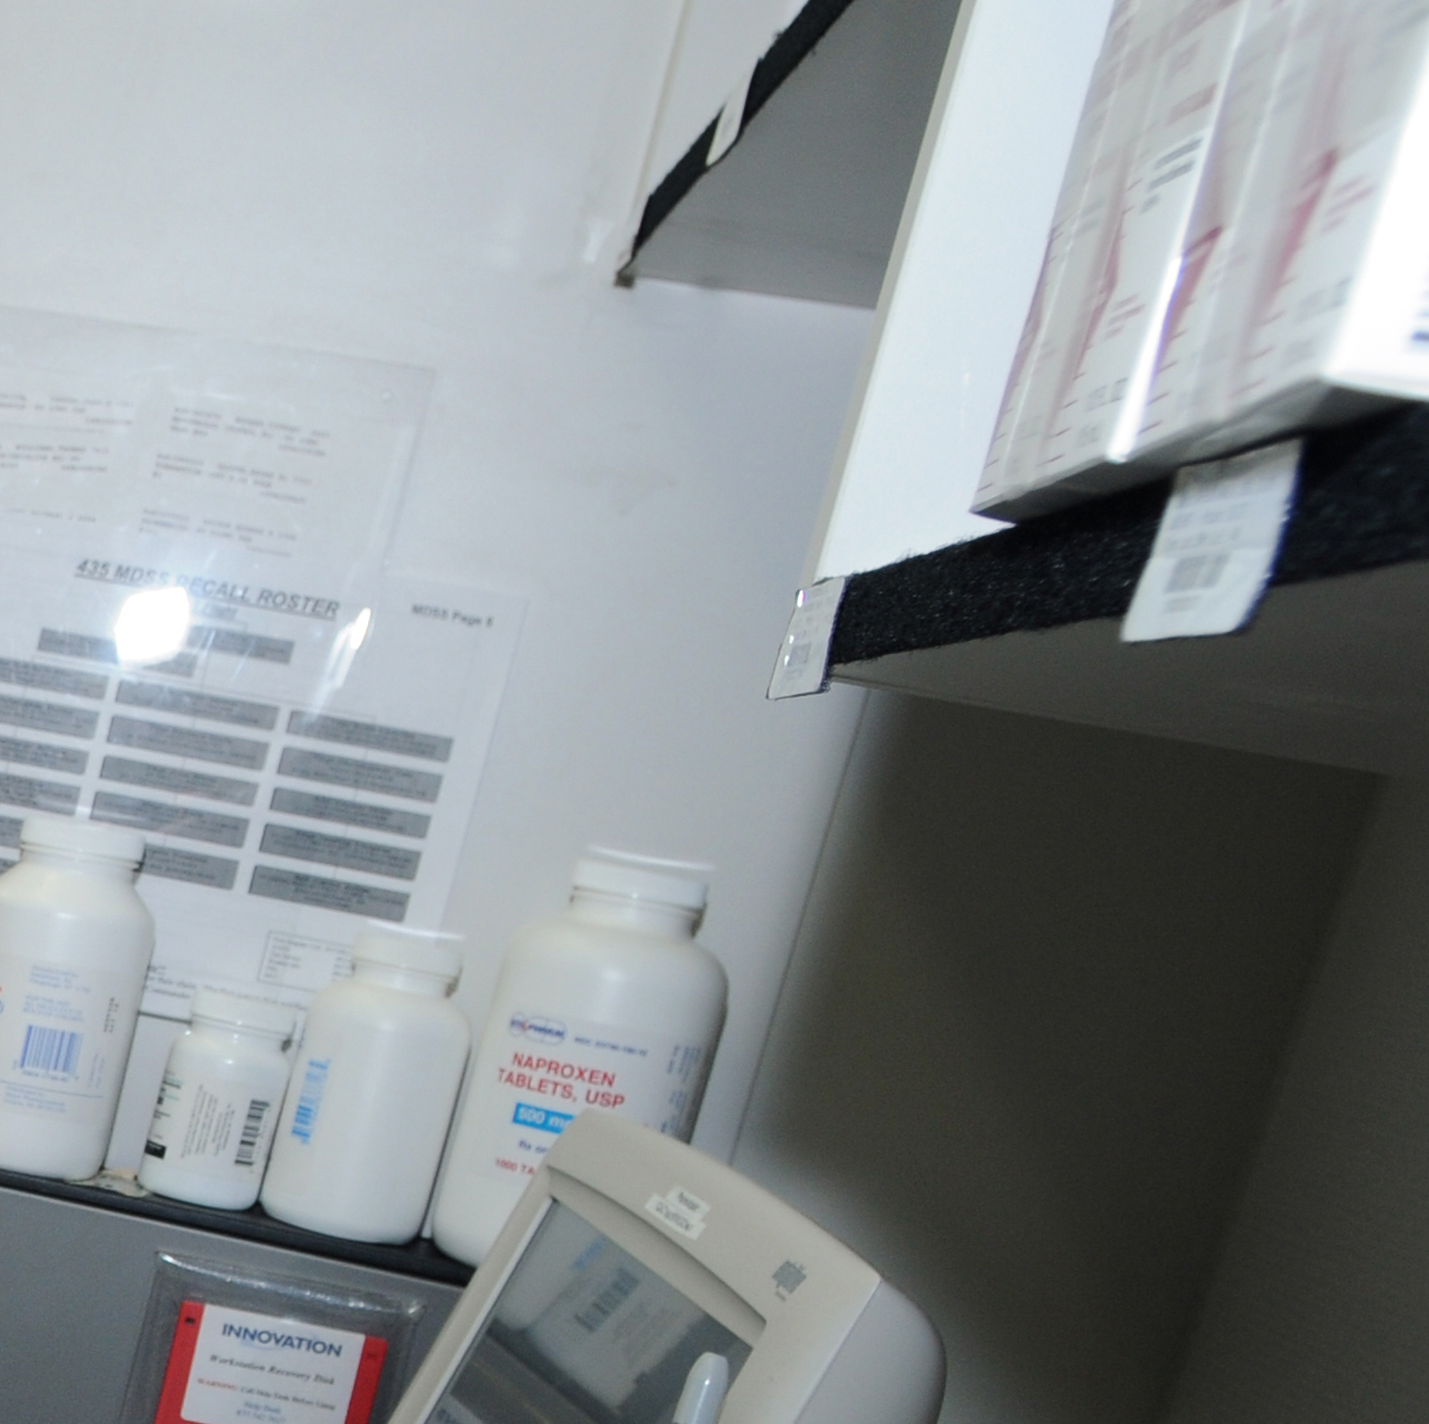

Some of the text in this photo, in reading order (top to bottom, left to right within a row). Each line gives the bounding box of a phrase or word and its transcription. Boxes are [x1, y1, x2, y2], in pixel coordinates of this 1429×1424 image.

[76, 557, 110, 579] 435
[256, 587, 341, 619] ROSTER
[509, 1052, 617, 1087] NAPROXEN
[495, 1067, 626, 1109] TABLETS, USP
[518, 1107, 545, 1124] 500
[221, 1322, 343, 1358] INNOVATION
[208, 1353, 335, 1385] Workstation Recovery Disk
